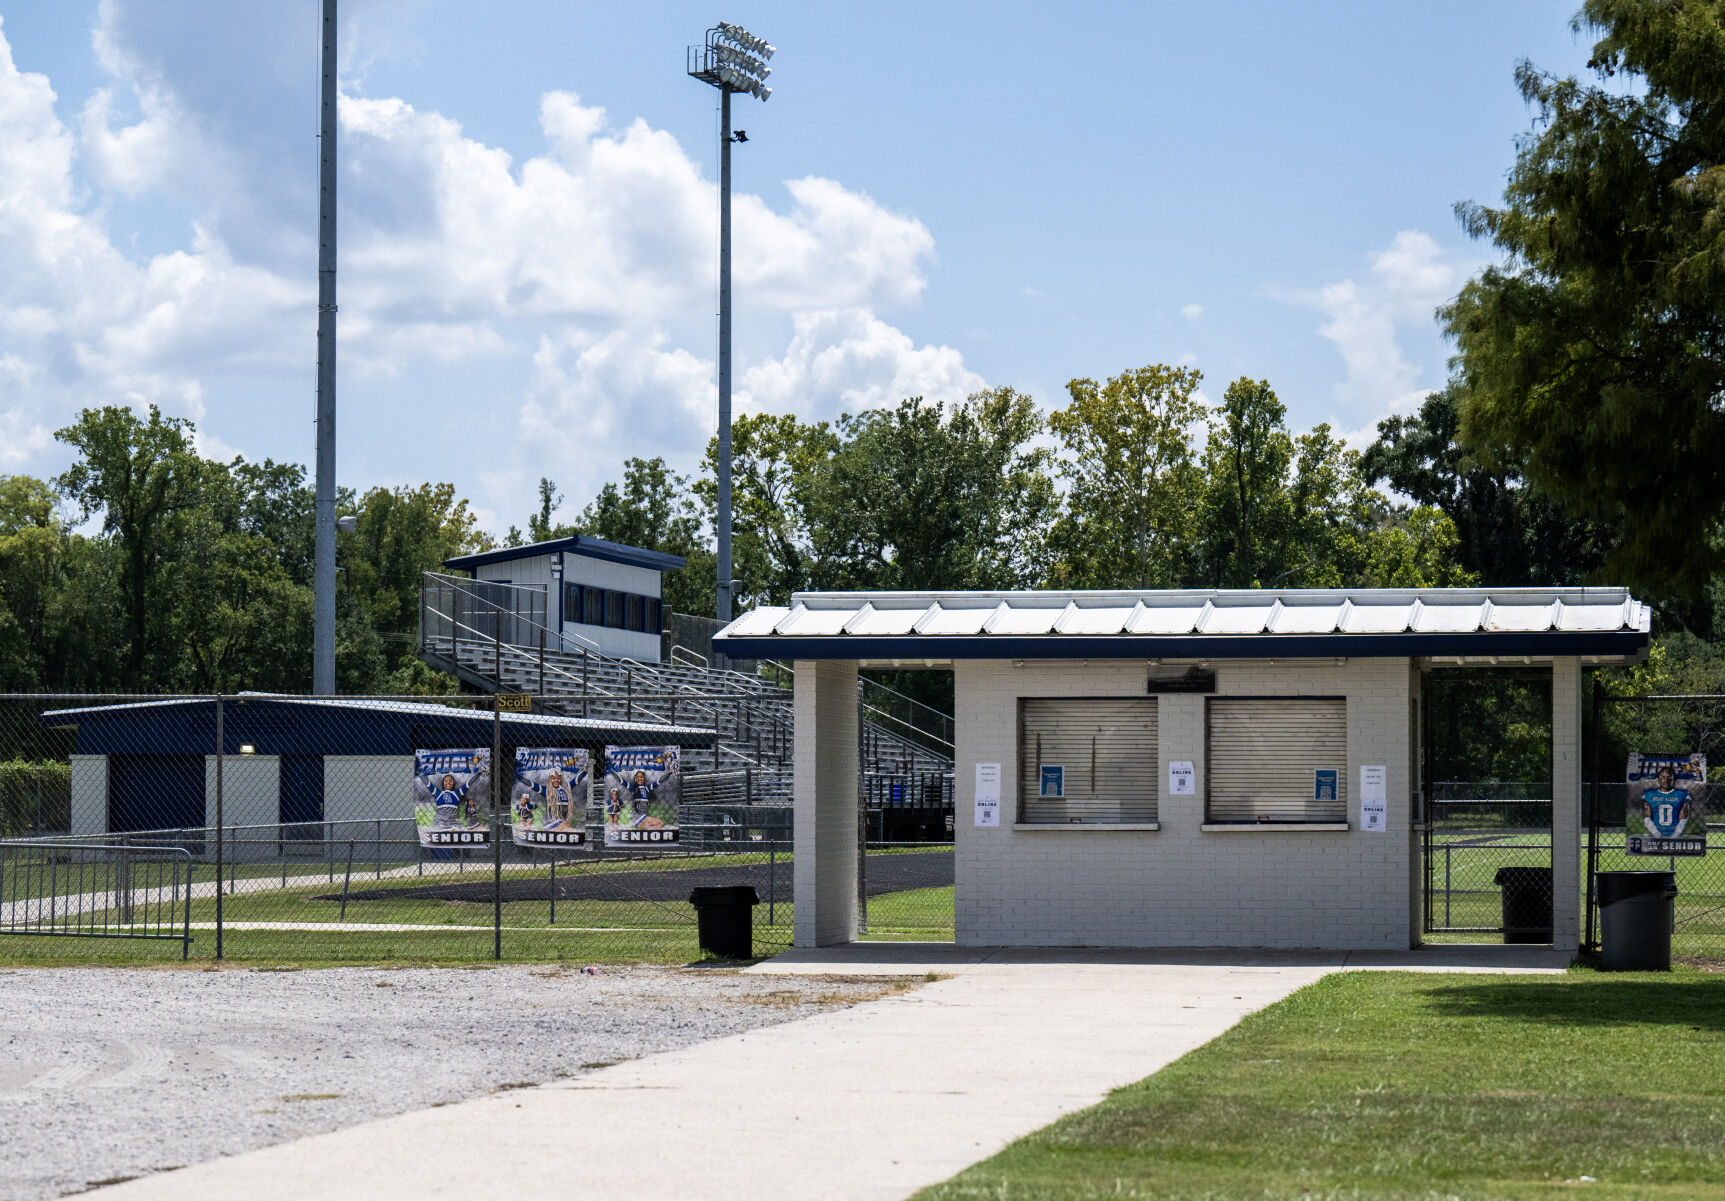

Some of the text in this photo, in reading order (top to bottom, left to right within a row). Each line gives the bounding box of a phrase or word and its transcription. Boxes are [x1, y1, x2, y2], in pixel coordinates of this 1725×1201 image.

[1658, 803, 1673, 826] 0
[423, 832, 484, 843] SENIOR
[517, 831, 580, 843] SENIOR
[609, 831, 674, 841] SENIOR
[1662, 841, 1701, 850] SENIOR
